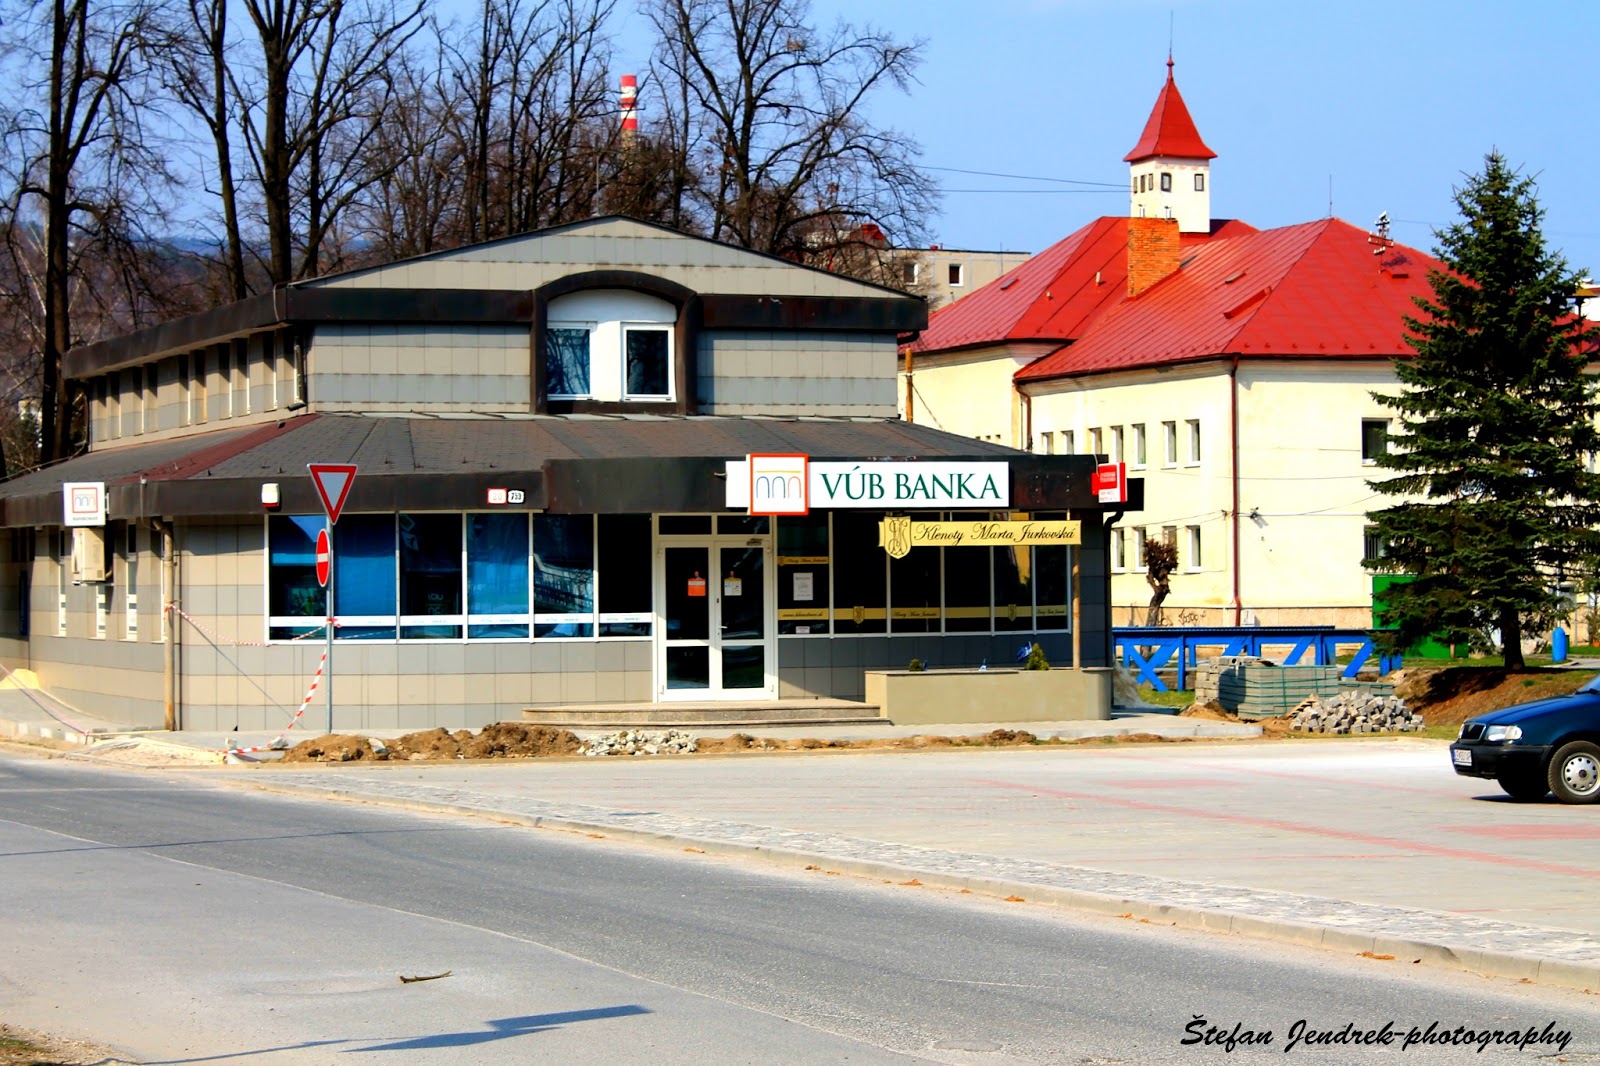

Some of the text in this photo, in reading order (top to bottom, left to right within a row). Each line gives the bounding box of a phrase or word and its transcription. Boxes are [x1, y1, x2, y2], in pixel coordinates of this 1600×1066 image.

[820, 465, 1002, 500] VÚB BANKA
[913, 522, 1077, 546] Klenoty Marta Jurkovská
